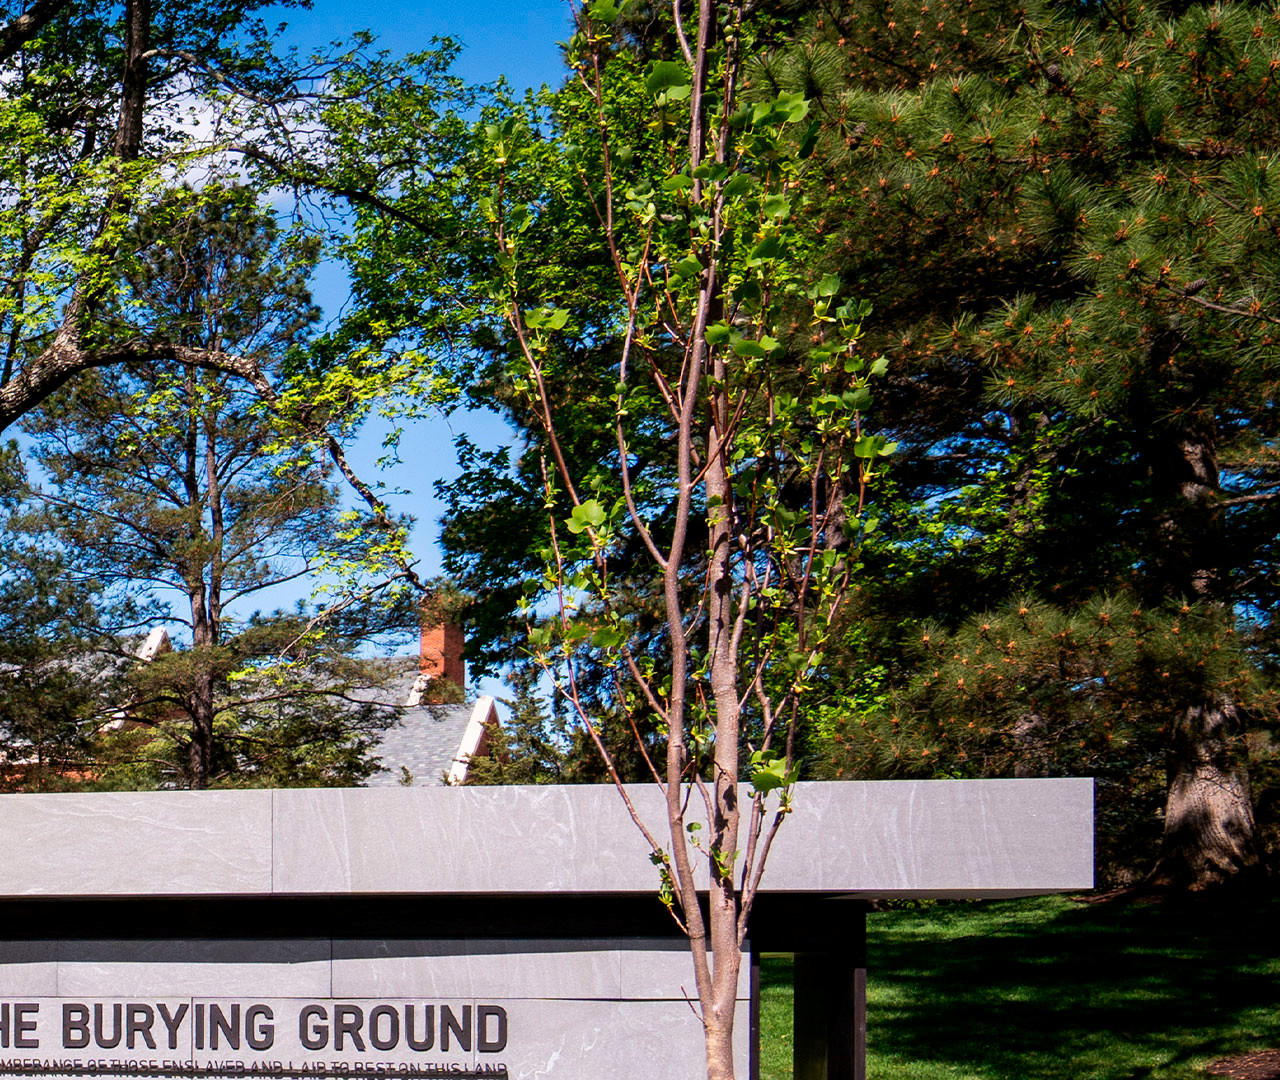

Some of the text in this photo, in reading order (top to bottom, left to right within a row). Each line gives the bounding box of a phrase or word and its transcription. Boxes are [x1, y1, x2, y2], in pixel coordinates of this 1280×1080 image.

[62, 1004, 275, 1050] BURYING
[300, 1005, 508, 1052] GROUND
[251, 1061, 283, 1078] AND
[354, 1062, 395, 1080] REST
[425, 1063, 460, 1080] THIS
